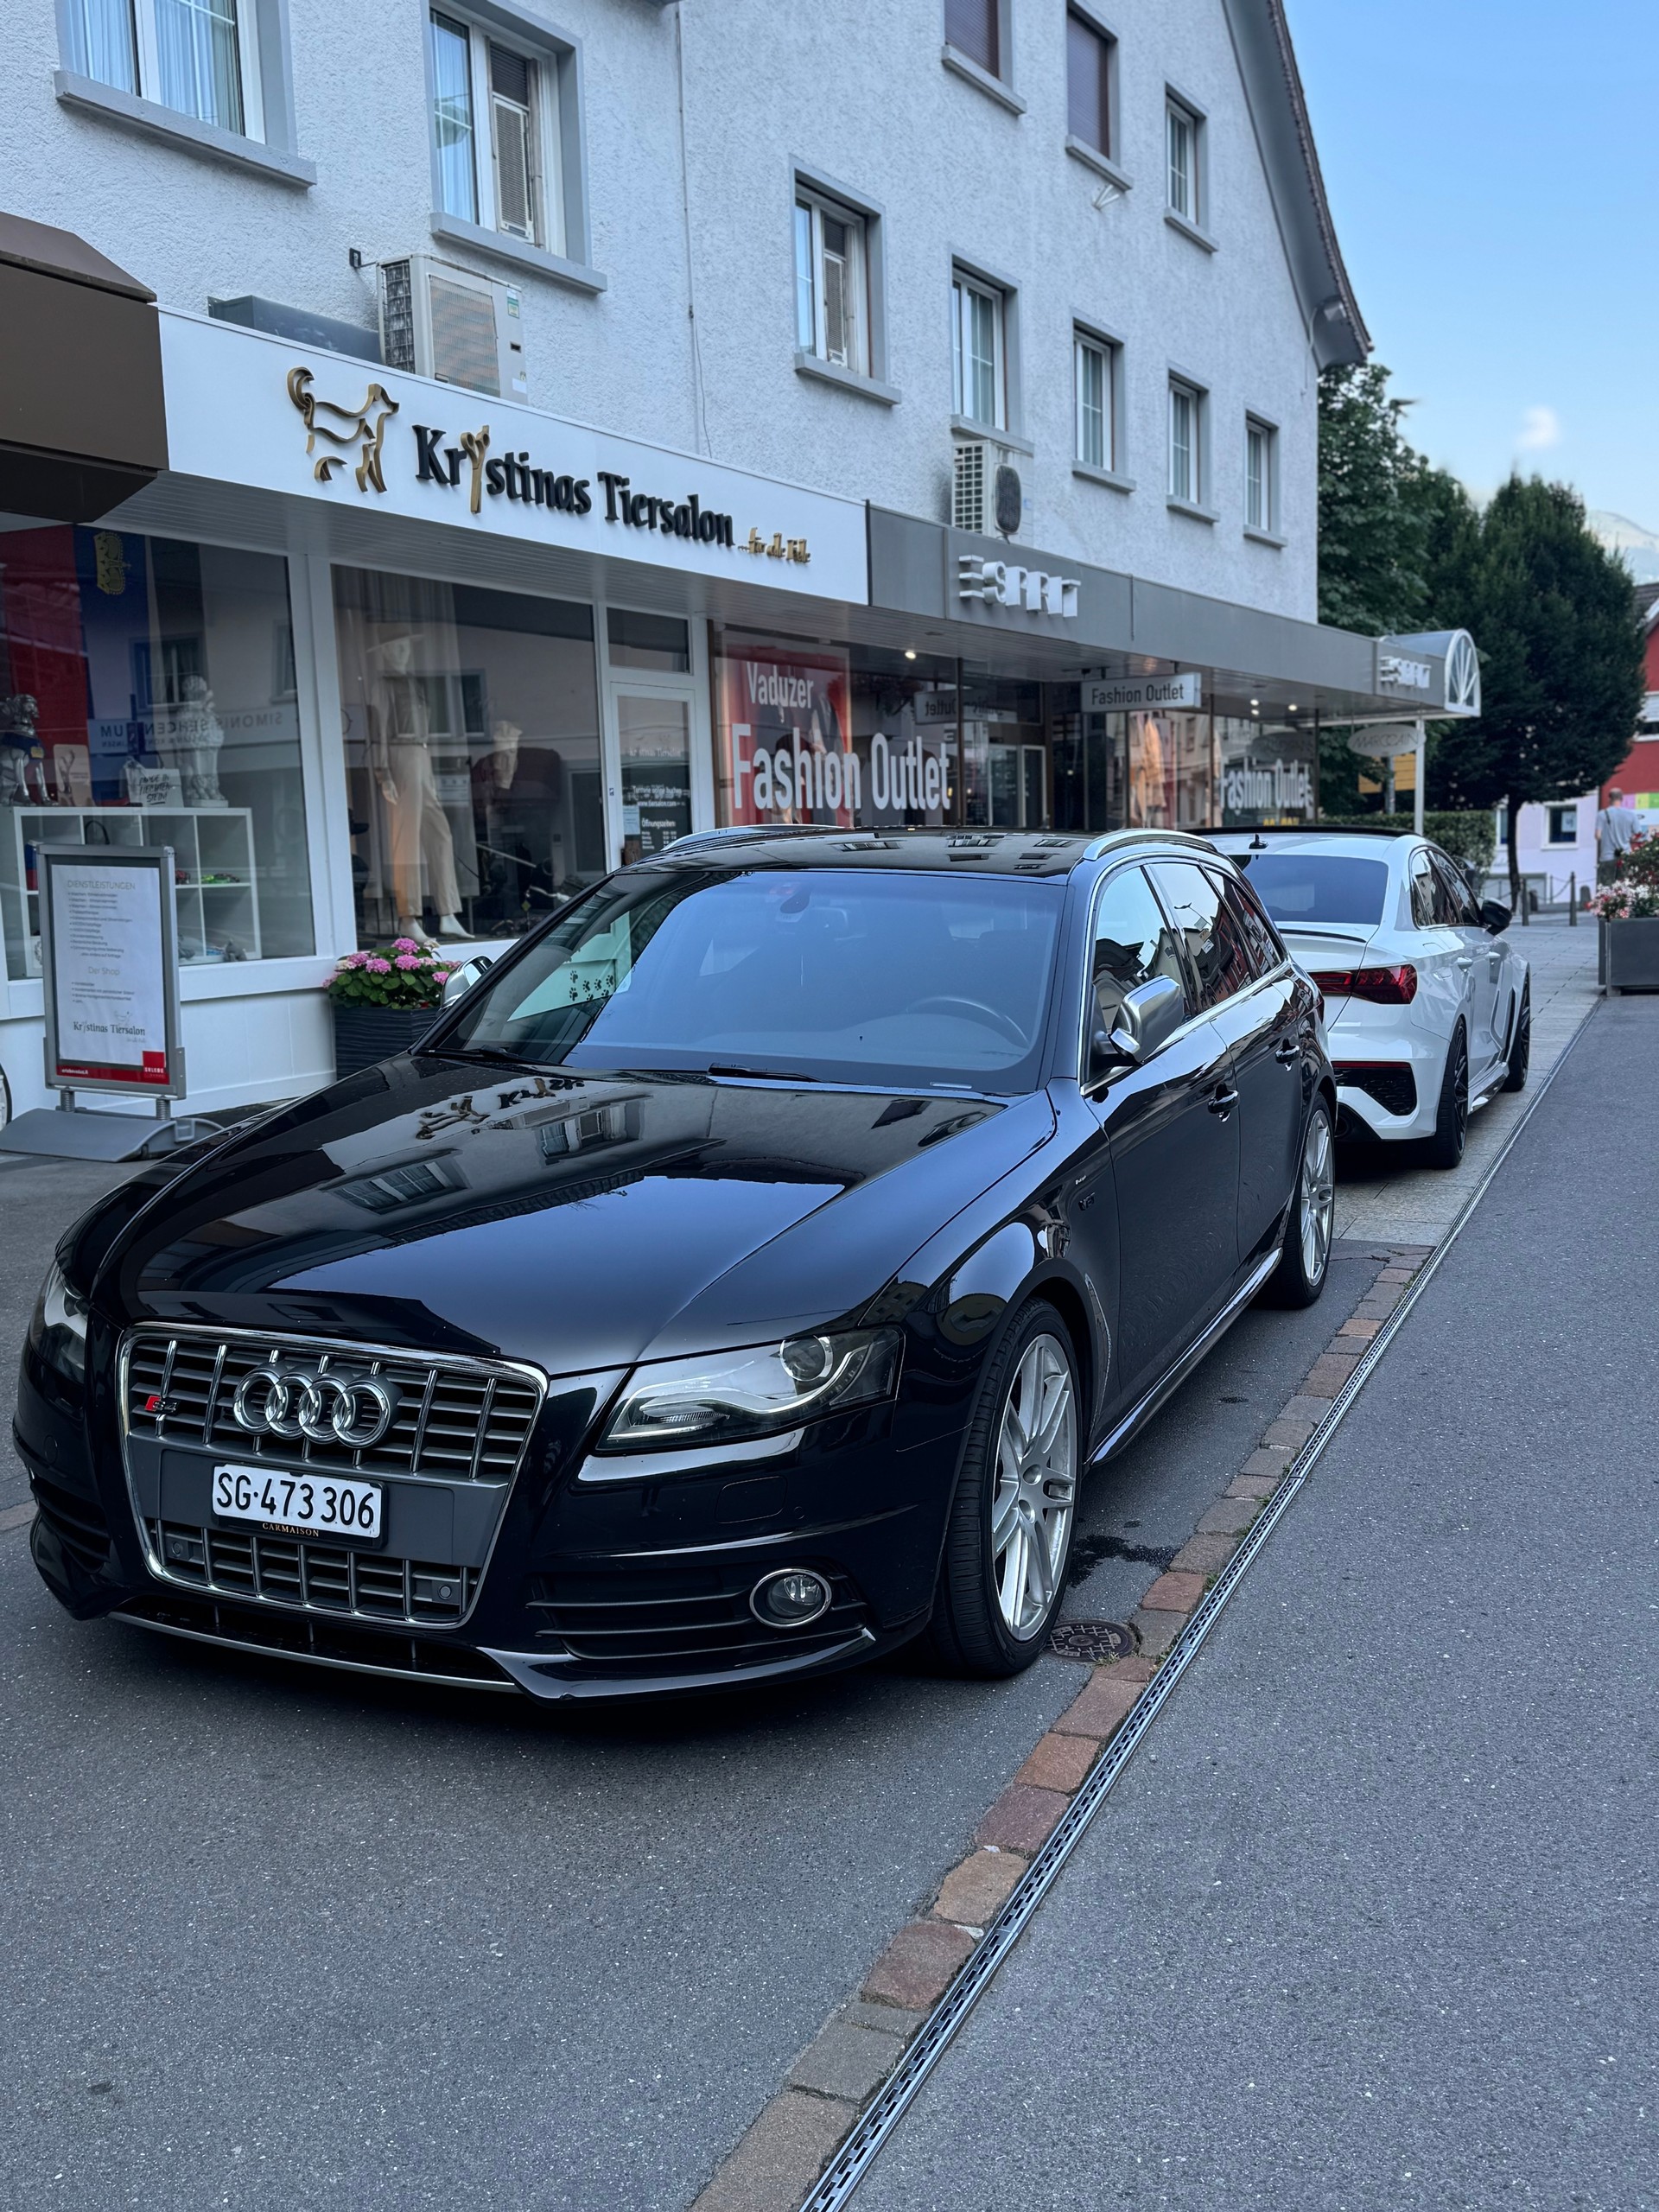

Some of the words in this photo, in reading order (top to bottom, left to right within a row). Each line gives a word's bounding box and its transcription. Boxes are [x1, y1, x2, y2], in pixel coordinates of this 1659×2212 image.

[596, 471, 735, 547] Tiersalon
[958, 554, 1081, 618] ESPRIT
[747, 661, 814, 709] Vaduzer
[1091, 684, 1141, 705] Fashion
[1146, 683, 1184, 702] Outlet
[732, 723, 861, 810] Fashion
[871, 733, 950, 810] Outlet
[1219, 757, 1271, 810] Fashion
[1274, 759, 1309, 809] Outlet
[67, 880, 136, 890] DIENSTLEISTUNGEN
[88, 966, 100, 975] Der
[101, 967, 120, 976] Shop
[110, 1024, 146, 1036] Tiersalon
[262, 1522, 320, 1537] CARMAISON
